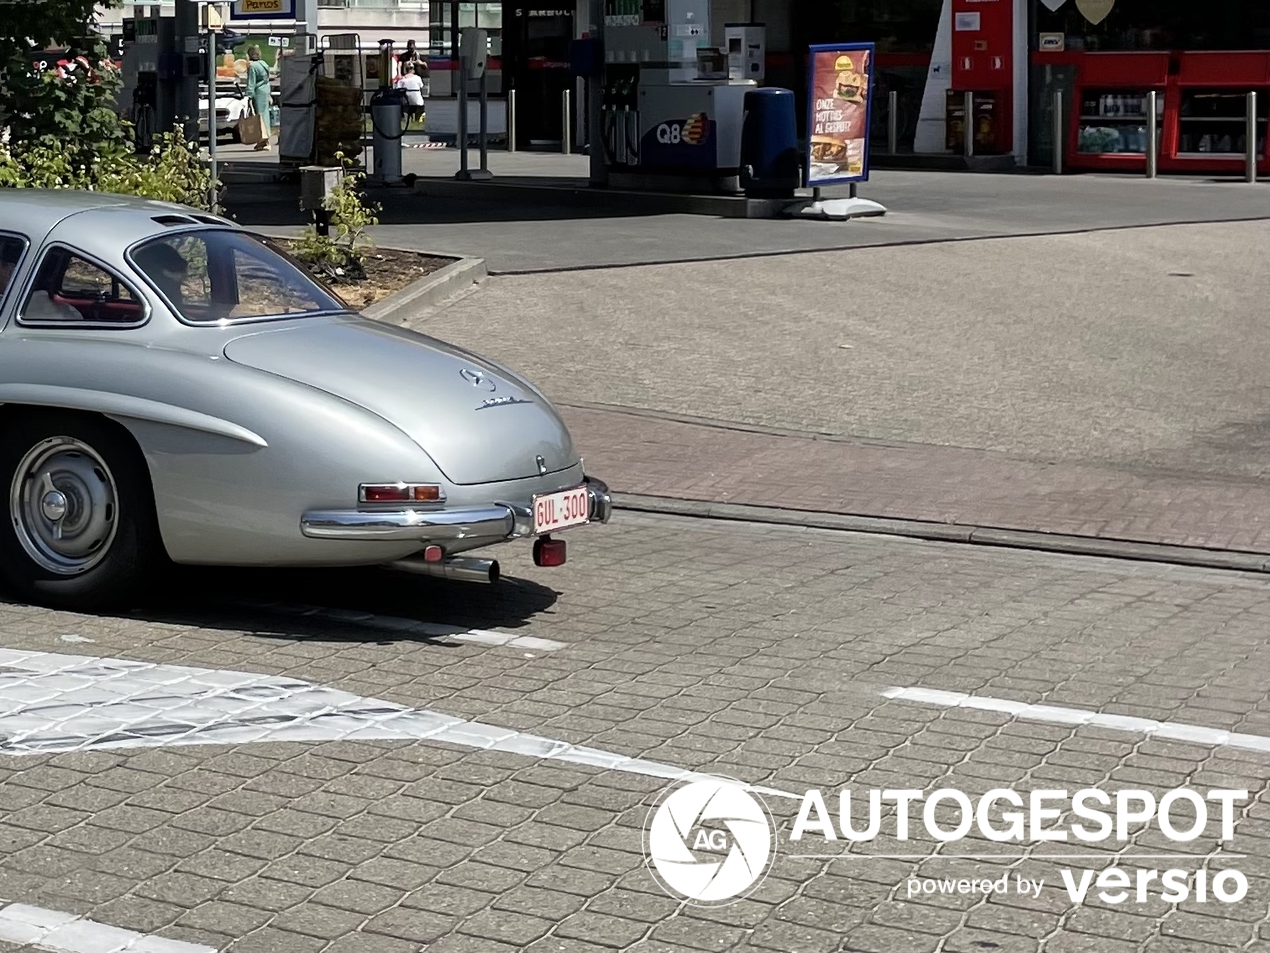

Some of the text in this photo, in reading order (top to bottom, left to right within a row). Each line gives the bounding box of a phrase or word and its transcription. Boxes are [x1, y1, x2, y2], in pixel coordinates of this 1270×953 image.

[246, 0, 279, 9] Panos
[816, 98, 835, 111] ONZE
[657, 123, 680, 144] Q8
[815, 123, 824, 134] AL
